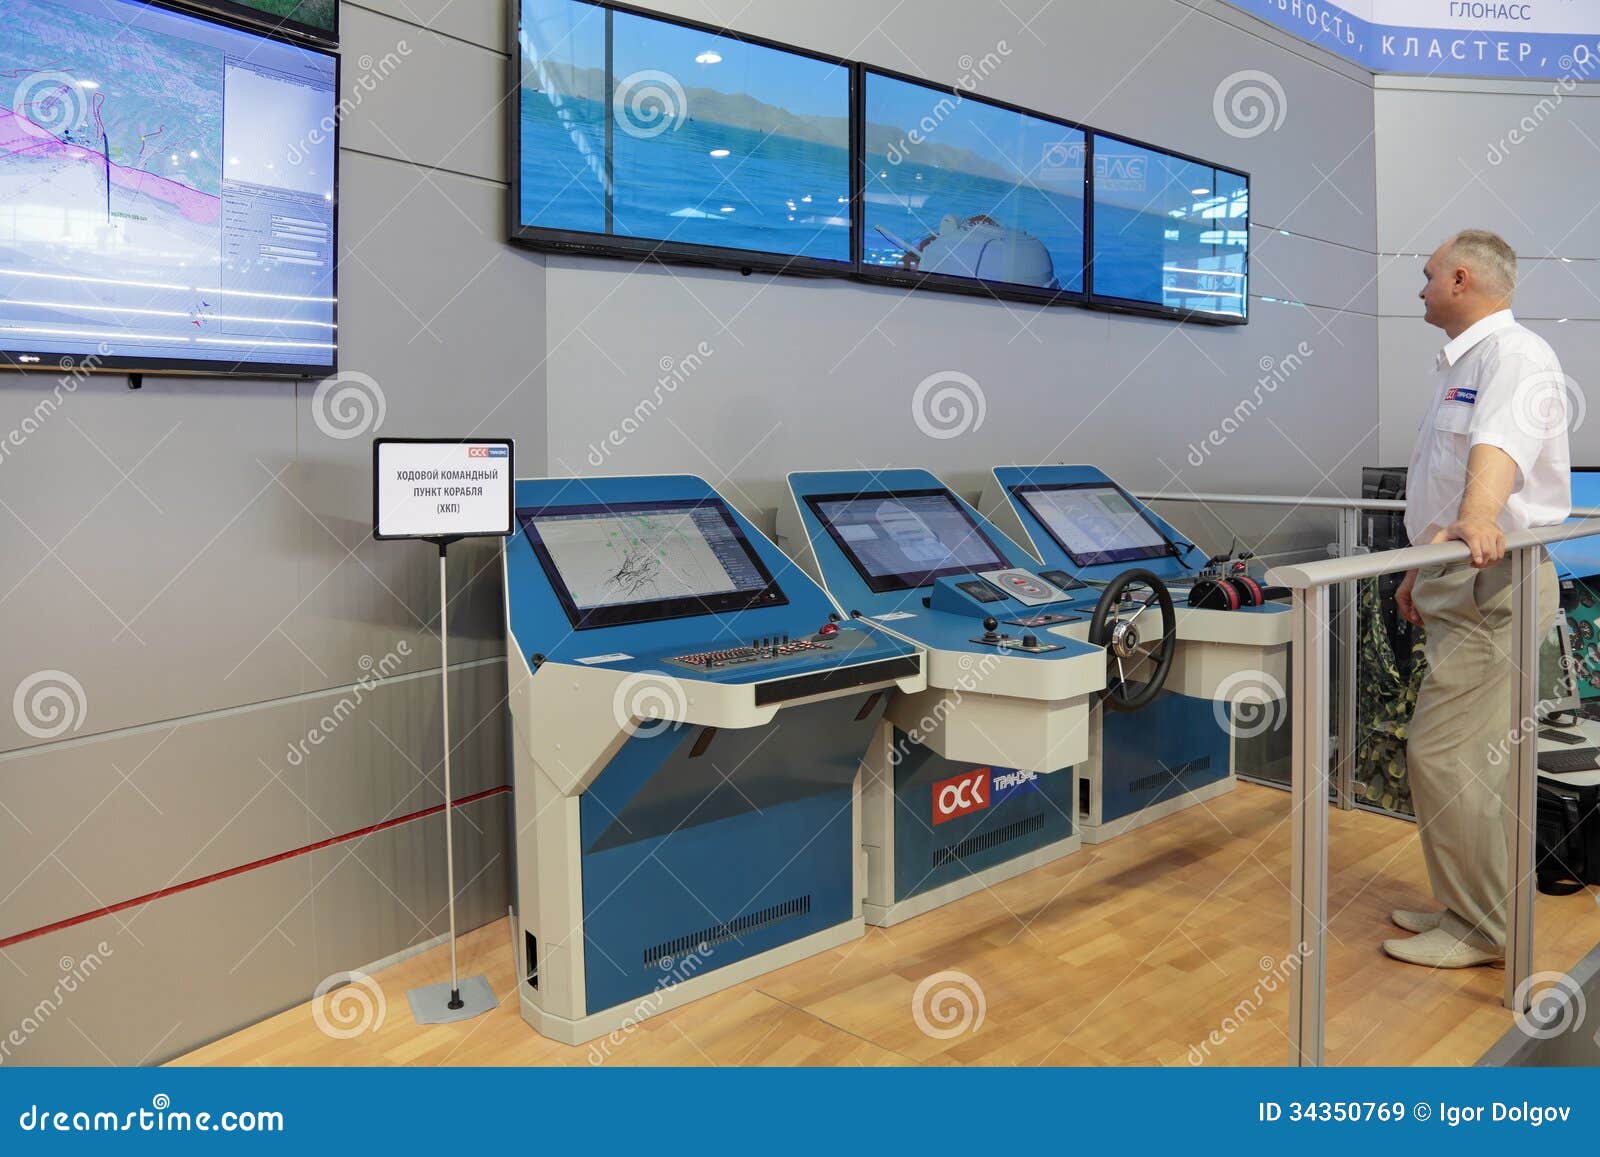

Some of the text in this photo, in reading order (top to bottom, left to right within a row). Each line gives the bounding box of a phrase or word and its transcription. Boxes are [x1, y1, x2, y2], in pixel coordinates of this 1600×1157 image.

[1449, 2, 1531, 20] ГЛОНАСС
[1268, 0, 1363, 52] ЬНОСТЬ,
[1382, 36, 1547, 67] КЛАСТЕР,
[396, 468, 498, 481] ХОДОВОЙ КОМАНДНЫЙ
[413, 486, 483, 497] ПУНКТ КОРАБЛЯ
[437, 503, 460, 514] (ХКП)
